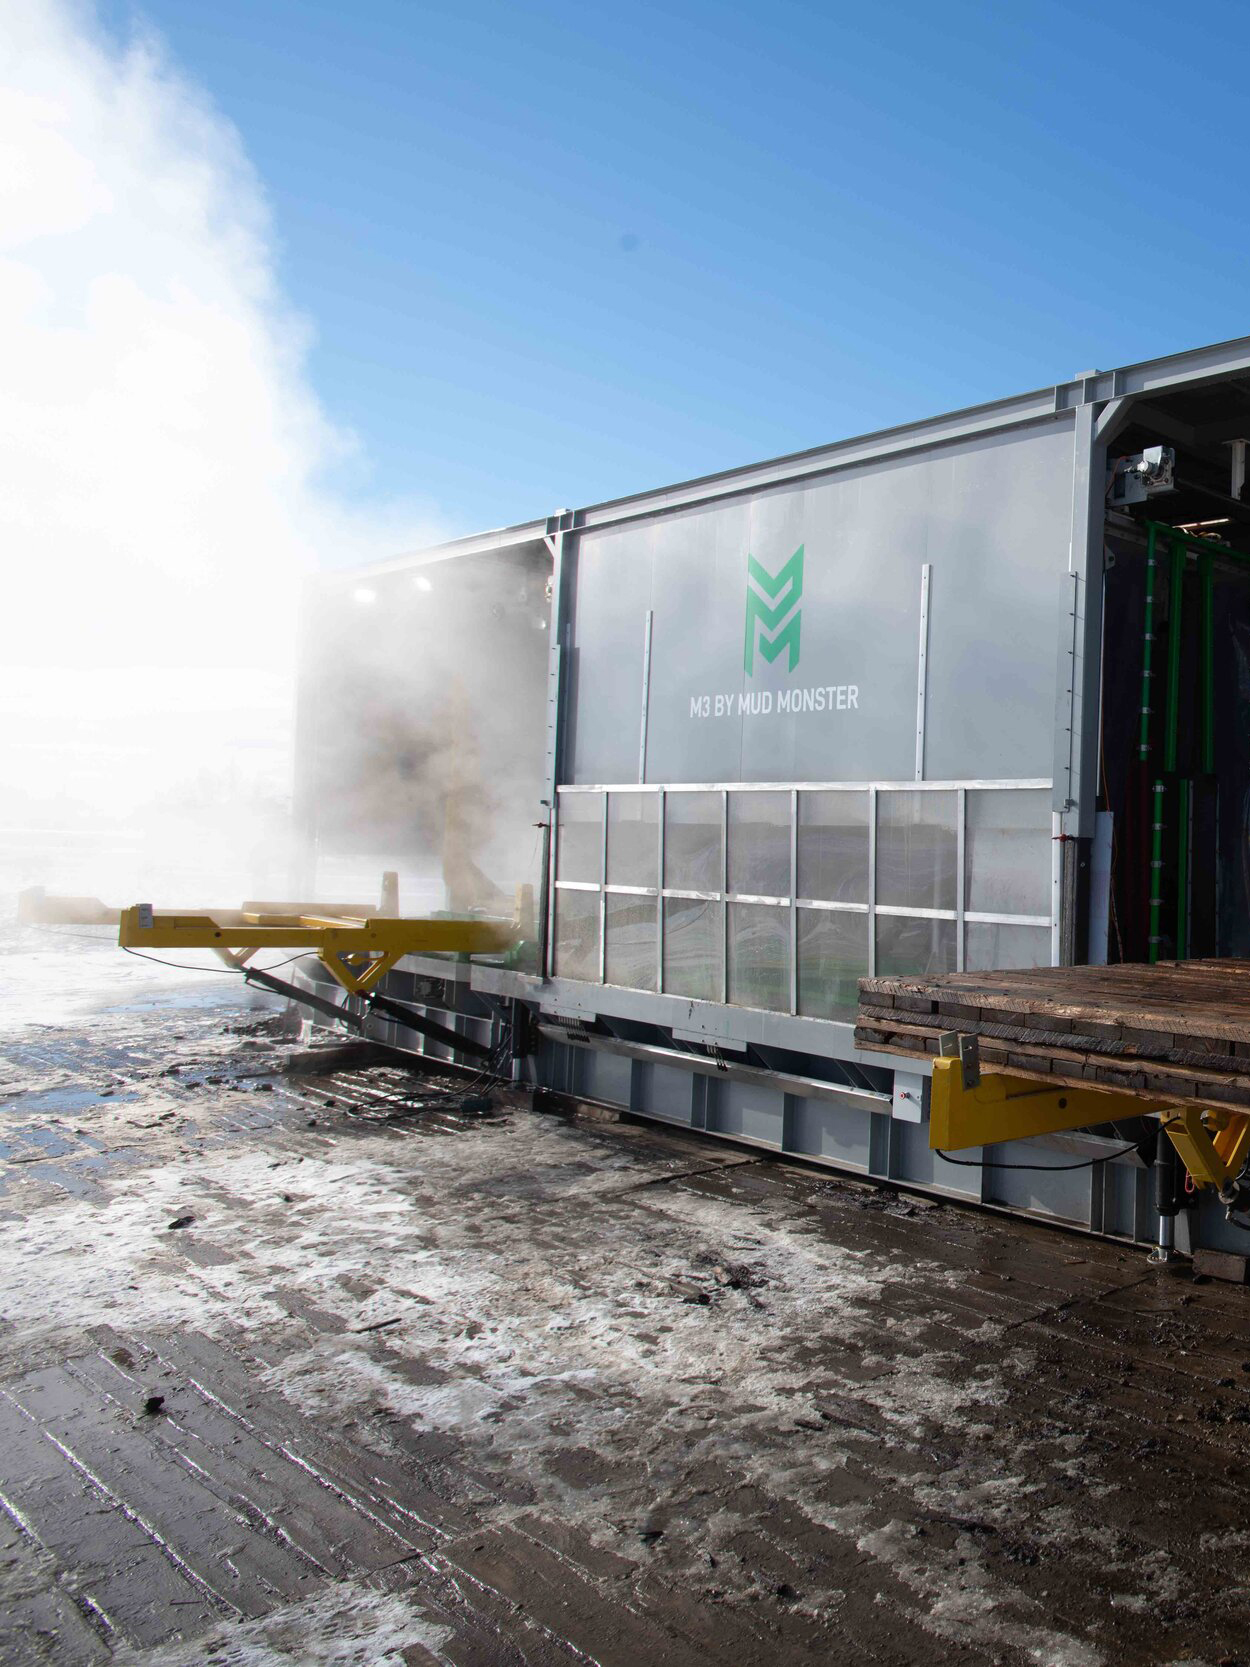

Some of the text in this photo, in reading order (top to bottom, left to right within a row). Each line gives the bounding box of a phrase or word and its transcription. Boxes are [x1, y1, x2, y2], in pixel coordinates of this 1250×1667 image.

[690, 685, 859, 718] M3 BY MUD MONSTER
